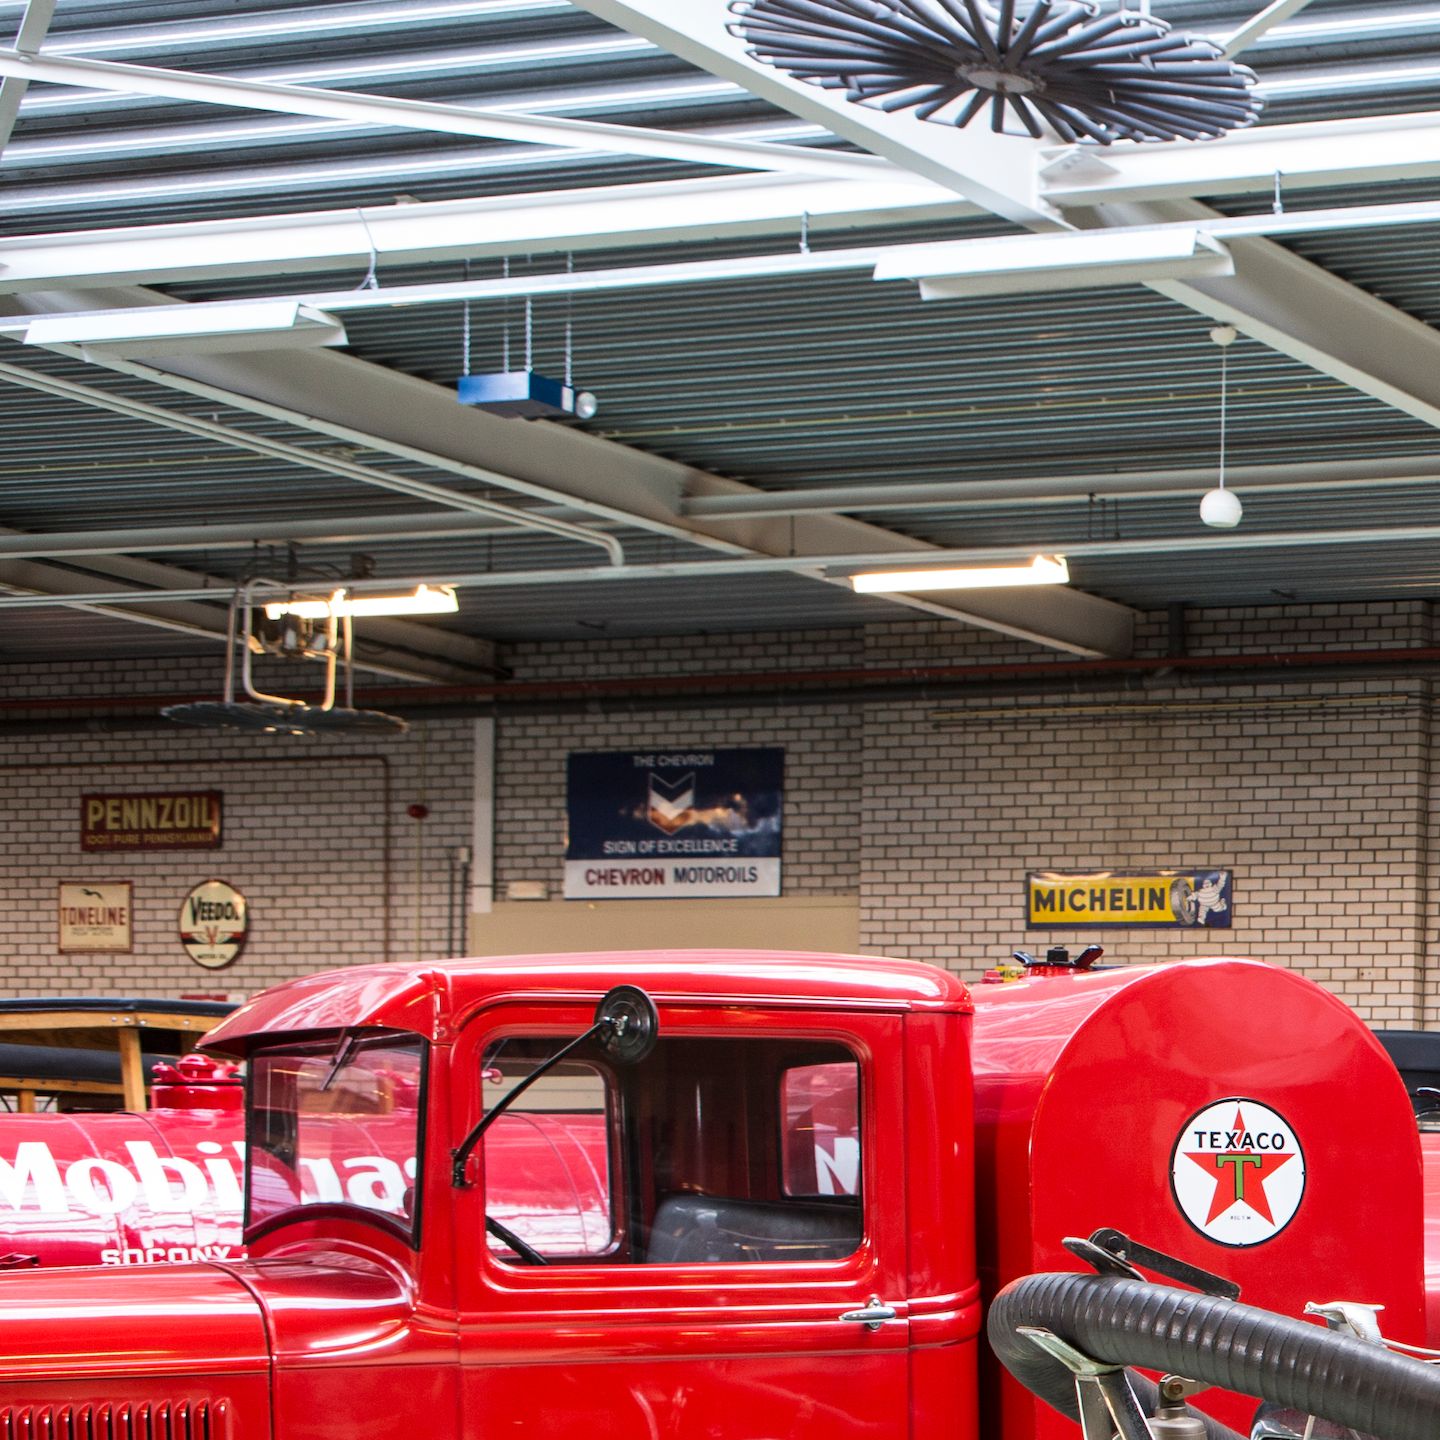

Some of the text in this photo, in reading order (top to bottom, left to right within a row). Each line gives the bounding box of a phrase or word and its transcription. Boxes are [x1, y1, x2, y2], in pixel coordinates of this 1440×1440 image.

[633, 754, 714, 768] THE CHEVRON
[87, 797, 213, 831] PENNZOIL
[603, 838, 739, 855] SIGN OF EXCELLENCE
[585, 866, 758, 886] CHEVRON MOTOROILS
[1033, 887, 1165, 913] MICHELIN
[62, 907, 126, 926] TONELINE
[1193, 1131, 1286, 1150] TEXACO
[100, 1245, 231, 1267] SOCONY
